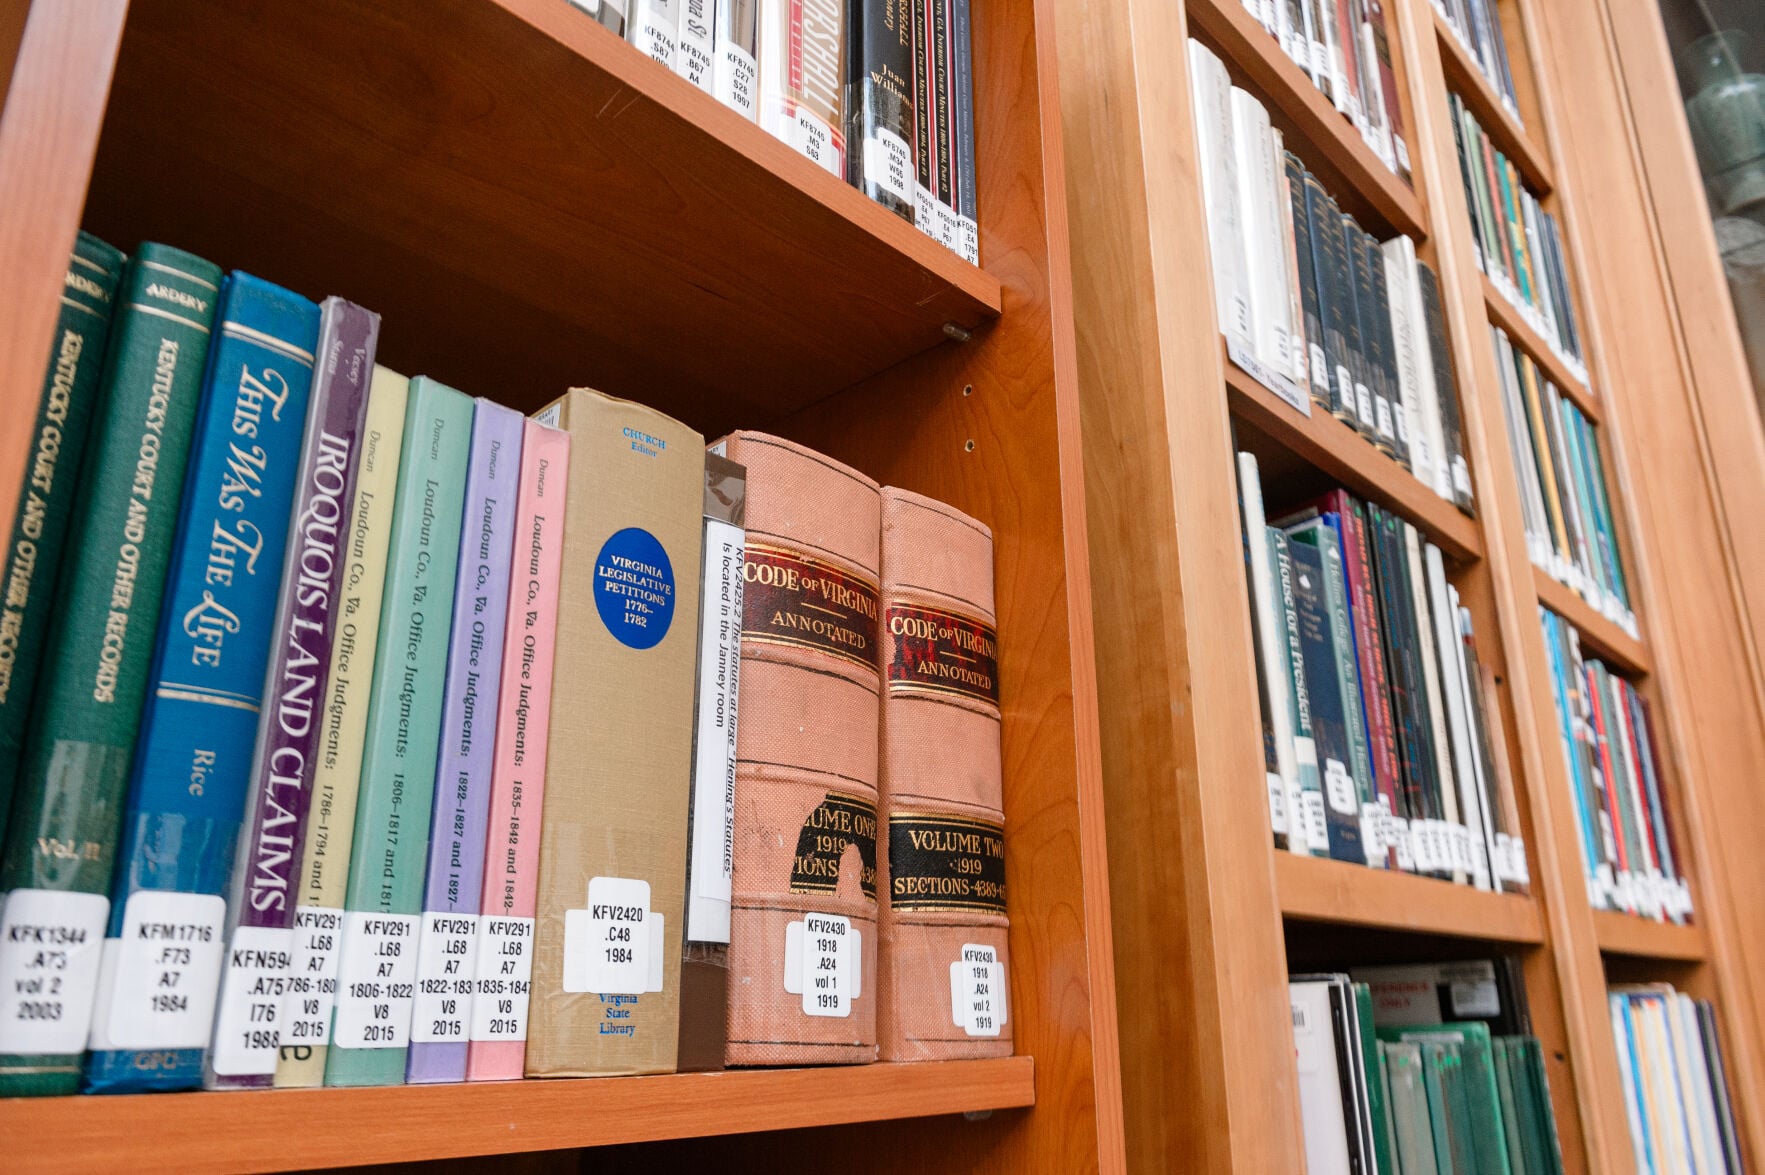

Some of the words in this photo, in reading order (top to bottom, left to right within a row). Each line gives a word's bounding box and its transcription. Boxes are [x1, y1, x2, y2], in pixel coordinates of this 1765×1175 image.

[680, 41, 710, 67] KF8745
[727, 52, 755, 77] KF8745
[686, 59, 704, 74] .B67
[733, 68, 749, 84] .C27
[882, 63, 905, 87] Juan
[689, 72, 700, 85] A4
[732, 92, 750, 109] 1997
[801, 118, 825, 142] KF8745
[882, 138, 906, 160] KF8745
[889, 175, 904, 190] 1998
[146, 283, 207, 313] ARDERY
[145, 337, 180, 437] KENTUCKY
[232, 363, 289, 439] THIS
[430, 417, 445, 460] Duncan
[623, 427, 667, 450] CHURCH
[367, 430, 381, 473] Duncan
[488, 439, 501, 480] Duncan
[631, 441, 658, 458] Editor
[133, 429, 161, 500] COURT
[218, 440, 268, 513] WAS
[537, 458, 549, 498] Duncan
[124, 497, 148, 544] AND
[296, 428, 350, 610] IROQUOIS
[420, 478, 440, 547] Loudoun
[353, 490, 374, 558] Loudoun
[480, 497, 497, 560] Loudoun
[530, 514, 545, 576] Loudoun
[1275, 533, 1287, 549] A
[205, 518, 264, 587] THE
[110, 543, 140, 609] OTHER
[611, 555, 663, 579] VIRGINIA
[720, 555, 732, 599] located
[598, 566, 672, 595] LEGISLATIVE
[733, 547, 744, 619] KFV2425.2
[1278, 553, 1293, 608] House
[410, 585, 427, 606] Va.
[605, 581, 666, 607] PETITIONS
[743, 561, 800, 591] CODE
[819, 578, 878, 622] VIRGINIA
[345, 595, 361, 618] Va.
[473, 595, 488, 616] Va.
[721, 603, 731, 617] in
[183, 589, 240, 668] LIFE
[524, 610, 538, 629] Va.
[623, 612, 647, 628] 1782
[719, 619, 730, 641] the
[770, 610, 866, 649] ANNOTATED
[890, 616, 938, 641] CODE
[1286, 609, 1298, 636] for
[405, 611, 424, 662] Office
[732, 621, 741, 644] The
[1289, 635, 1300, 647] a
[338, 621, 357, 673] Office
[469, 620, 485, 667] Office
[93, 609, 128, 703] RECORDS
[521, 634, 536, 679] Office
[278, 613, 323, 738] LAND
[715, 644, 729, 691] Janney
[730, 646, 740, 697] statutes
[918, 660, 991, 690] ANNOTATED
[1292, 650, 1312, 730] President
[395, 664, 418, 758] Judgments:
[460, 669, 480, 757] Judgments:
[716, 692, 725, 728] room
[730, 699, 737, 713] at
[324, 675, 350, 770] Judgments:
[514, 682, 532, 767] Judgments:
[729, 716, 737, 746] large
[188, 748, 216, 797] Rice
[250, 746, 305, 912] CLAIMS
[451, 841, 462, 868] and
[816, 835, 847, 854] 1919
[908, 829, 981, 854] VOLUME
[983, 836, 1005, 859] TWO
[383, 849, 396, 878] and
[506, 848, 516, 874] and
[957, 858, 982, 875] 1919
[310, 860, 323, 890] and
[296, 912, 342, 929] KFV291
[593, 905, 643, 922] KFV2420
[8, 924, 87, 945] KFK1344
[138, 923, 212, 942] KFM1716
[364, 920, 410, 937] KFV291
[433, 919, 476, 935] KFV291
[489, 921, 531, 937] KFV291
[605, 927, 631, 942] .C48
[808, 918, 845, 936] KFV2430
[305, 935, 333, 951] .L68
[374, 941, 401, 957] .L68
[442, 940, 467, 955] .L68
[498, 942, 522, 956] .L68
[817, 939, 837, 953] 1918
[155, 949, 190, 965] .F73
[307, 957, 325, 971] A7
[605, 948, 632, 964] 1984
[817, 958, 836, 970] .A24
[964, 951, 993, 964] KFV2430
[376, 963, 394, 977] A7
[444, 960, 460, 974] A7
[501, 961, 516, 975] A7
[973, 968, 988, 979] 1918
[15, 977, 43, 994] vol
[50, 978, 62, 994] 2
[159, 973, 181, 988] A7
[247, 977, 284, 996] .A75
[350, 983, 412, 999] 1806-1822
[815, 977, 829, 989] vol
[833, 976, 838, 989] 1
[974, 984, 989, 995] .A24
[150, 996, 188, 1012] 1984
[303, 999, 319, 1015] V8
[442, 1000, 456, 1014] V8
[498, 1000, 513, 1014] V8
[599, 993, 638, 1006] Virginia
[817, 995, 838, 1008] 1919
[973, 1001, 985, 1012] vol
[986, 1003, 991, 1012] 2
[17, 1003, 63, 1020] 2003
[250, 1004, 276, 1022] I76
[373, 1004, 389, 1019] V8
[606, 1008, 630, 1019] State
[292, 1021, 324, 1037] 2015
[364, 1025, 394, 1042] 2015
[433, 1021, 461, 1036] 2015
[490, 1019, 518, 1034] 2015
[599, 1023, 636, 1038] Library
[976, 1017, 992, 1029] 1919
[243, 1031, 280, 1049] 1988
